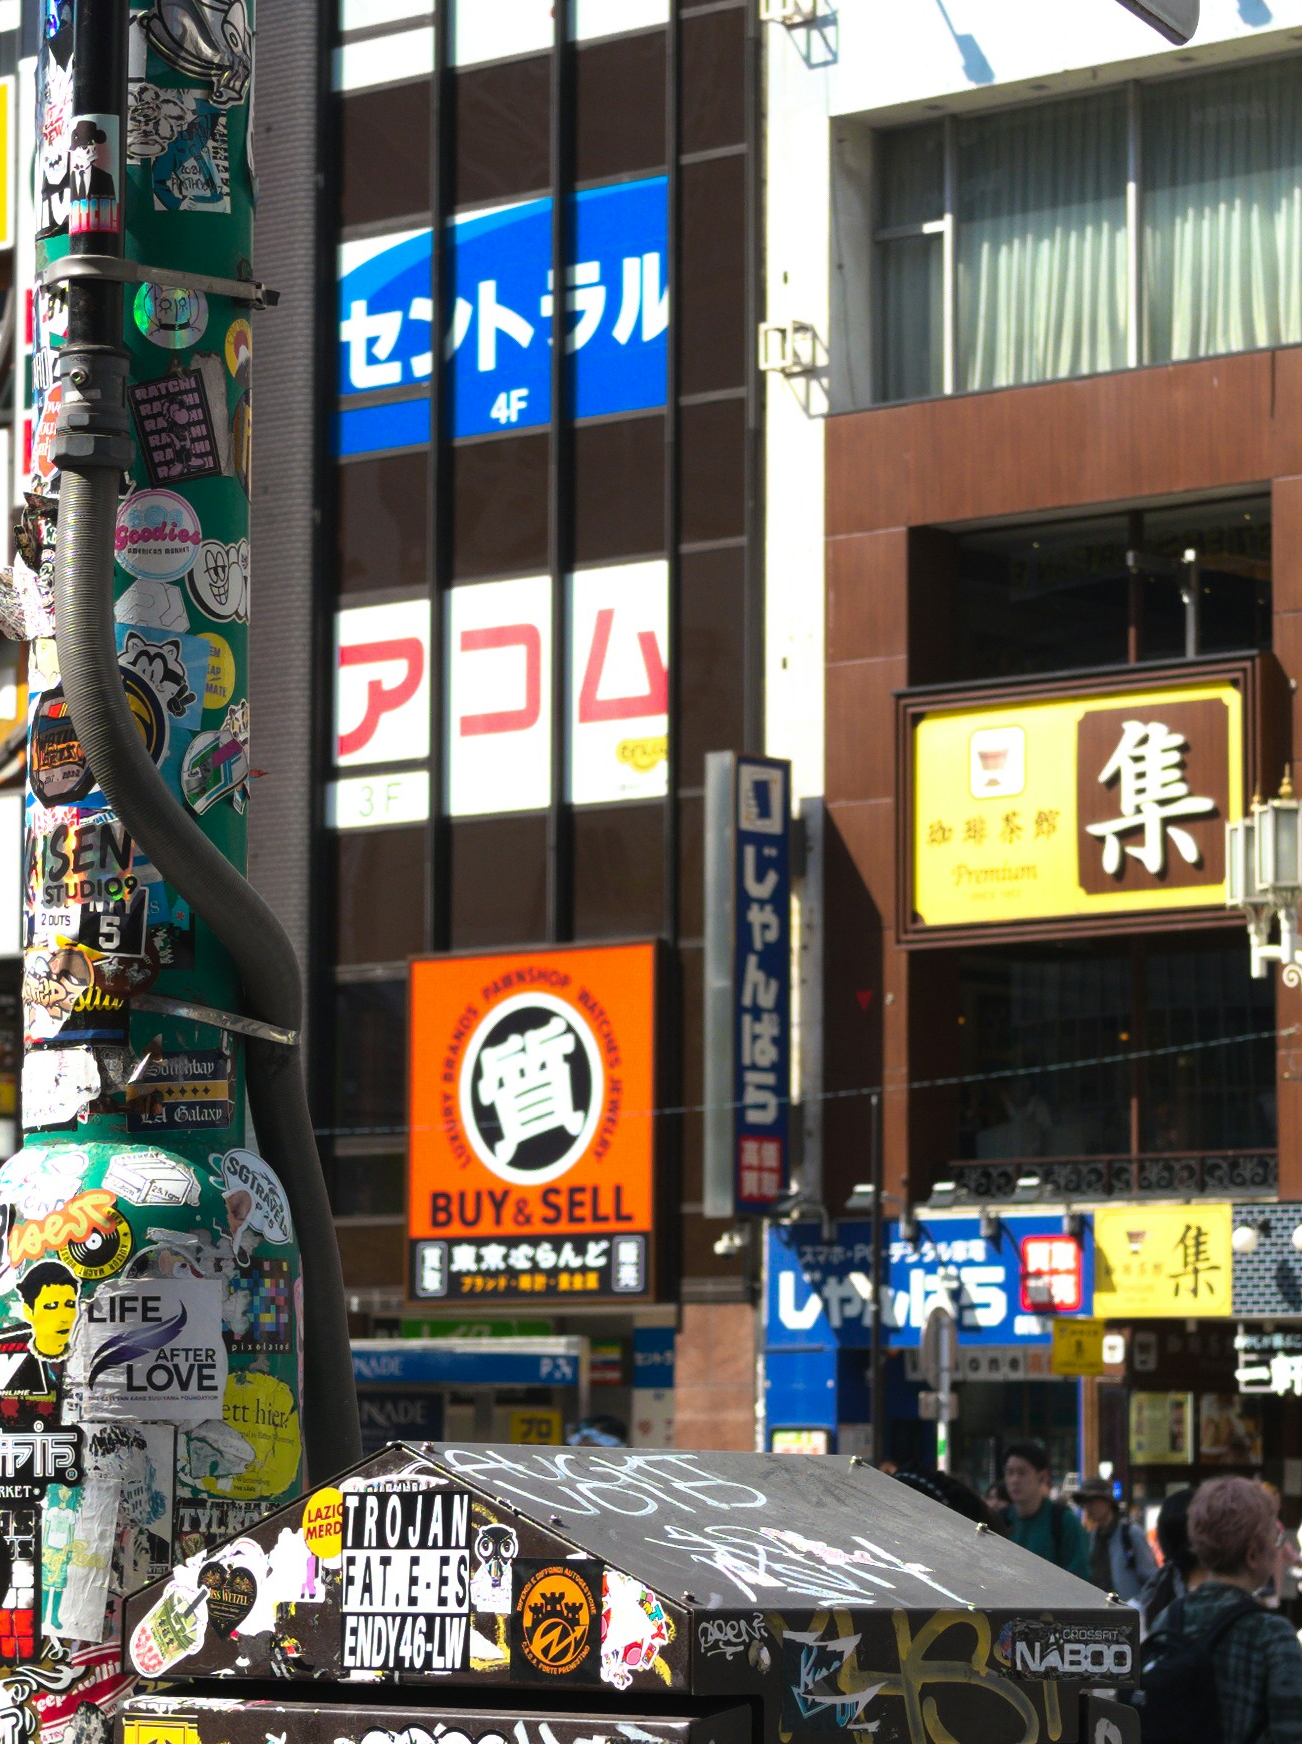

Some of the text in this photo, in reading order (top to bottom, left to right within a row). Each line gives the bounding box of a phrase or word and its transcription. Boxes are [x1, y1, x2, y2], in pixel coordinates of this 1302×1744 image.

[340, 251, 670, 390] セントラル
[134, 377, 197, 402] RATCHI
[490, 387, 530, 424] 4F
[114, 521, 203, 553] Goodies
[337, 607, 670, 757] アコム
[359, 782, 403, 817] 3F
[1084, 718, 1216, 876] 集
[925, 808, 1060, 848] 珈琲茶館
[43, 876, 138, 906] STUDIO9
[481, 965, 573, 1003] PAWNSHOP
[742, 842, 781, 1125] じゃんぱら
[443, 1004, 479, 1085] BRANDS
[576, 987, 624, 1070] WATCHES
[477, 1014, 589, 1168] 質
[174, 1105, 224, 1126] Galaxy
[594, 1075, 624, 1164] JEWELRY
[429, 1184, 634, 1229] BUY & SELL
[1170, 1224, 1222, 1300] 集
[88, 1295, 163, 1324] LIFE
[155, 1348, 217, 1363] AFTER
[231, 1341, 290, 1354] pixelated
[126, 1363, 218, 1393] LOVE
[222, 1404, 252, 1423] ett
[345, 1494, 469, 1548] TROJAN
[343, 1615, 467, 1671] ENDY46-LW
[1061, 1627, 1120, 1642] CROSSFIT
[1014, 1642, 1135, 1676] NABOO
